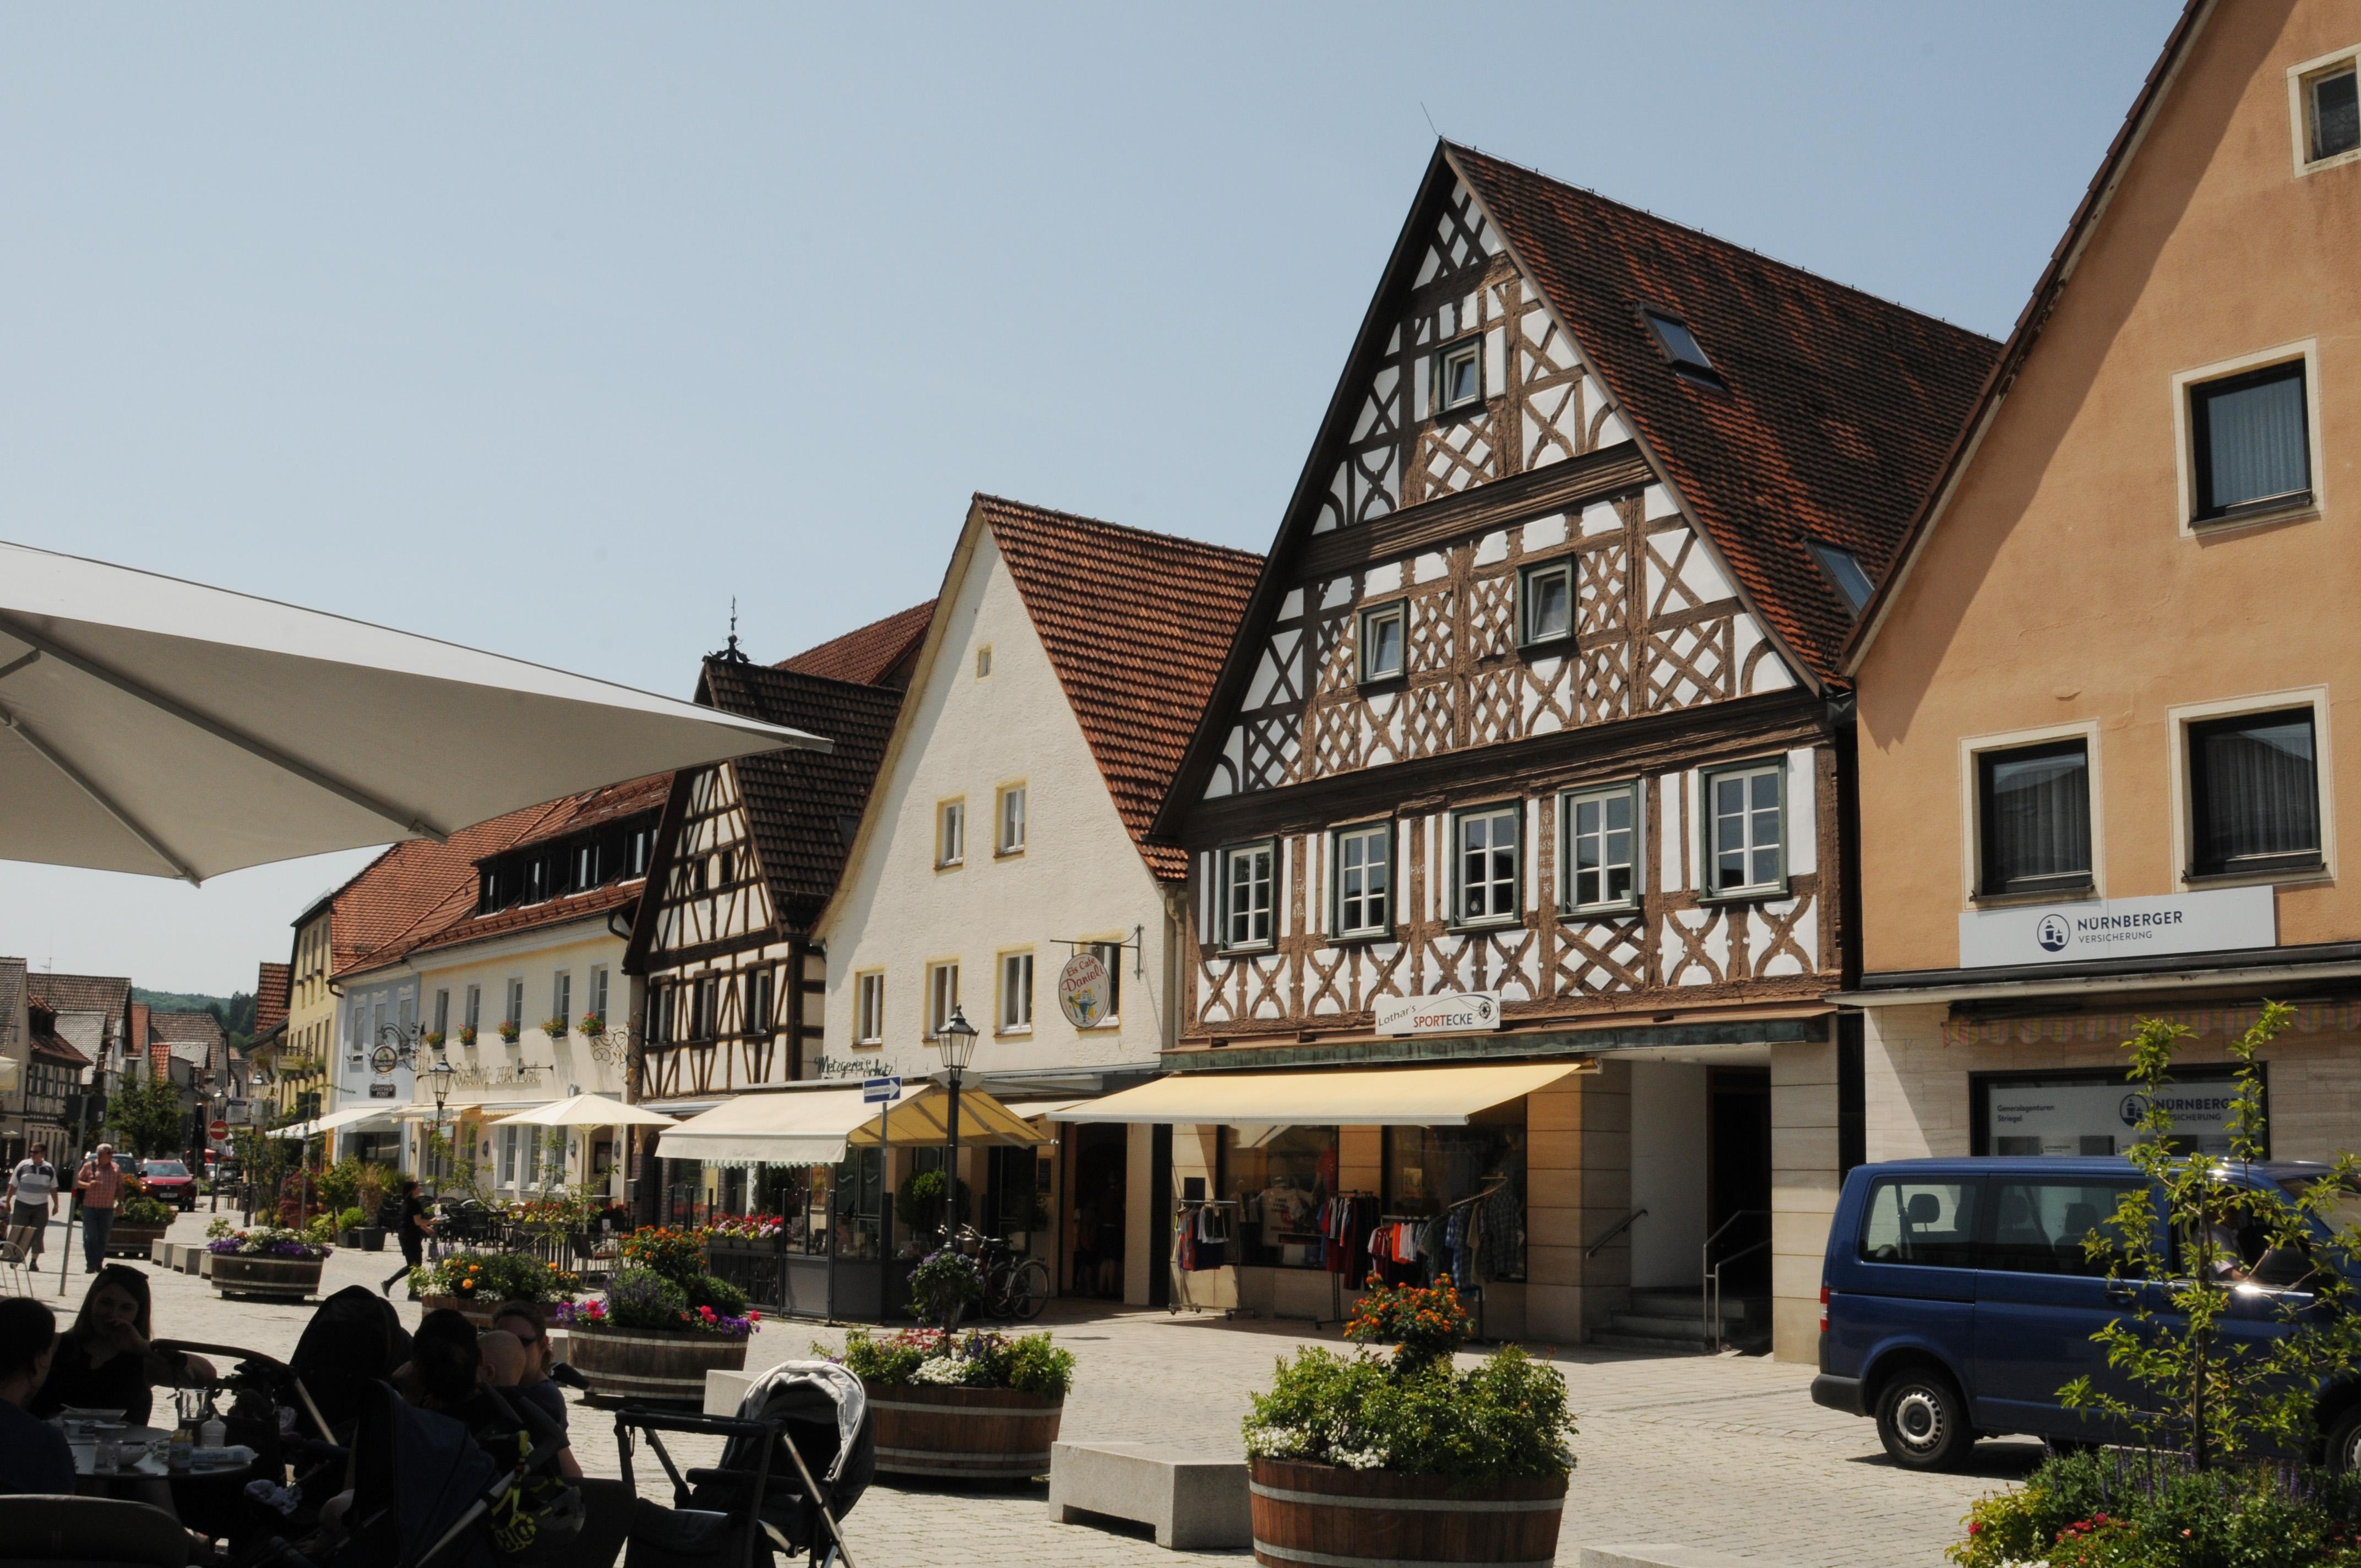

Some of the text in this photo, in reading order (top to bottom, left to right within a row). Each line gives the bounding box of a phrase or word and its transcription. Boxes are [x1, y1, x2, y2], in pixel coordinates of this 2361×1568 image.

[2077, 911, 2183, 931] NÜRNBERGER
[2079, 930, 2153, 943] VERSICHERUNG
[1061, 964, 1105, 992] Danieli
[1066, 967, 1079, 977] Eis
[1378, 1005, 1417, 1026] Lothar's
[1413, 1013, 1473, 1028] SPORTECKE
[2155, 1097, 2243, 1110] NÜRNBERG
[1997, 1115, 2022, 1124] Striegel
